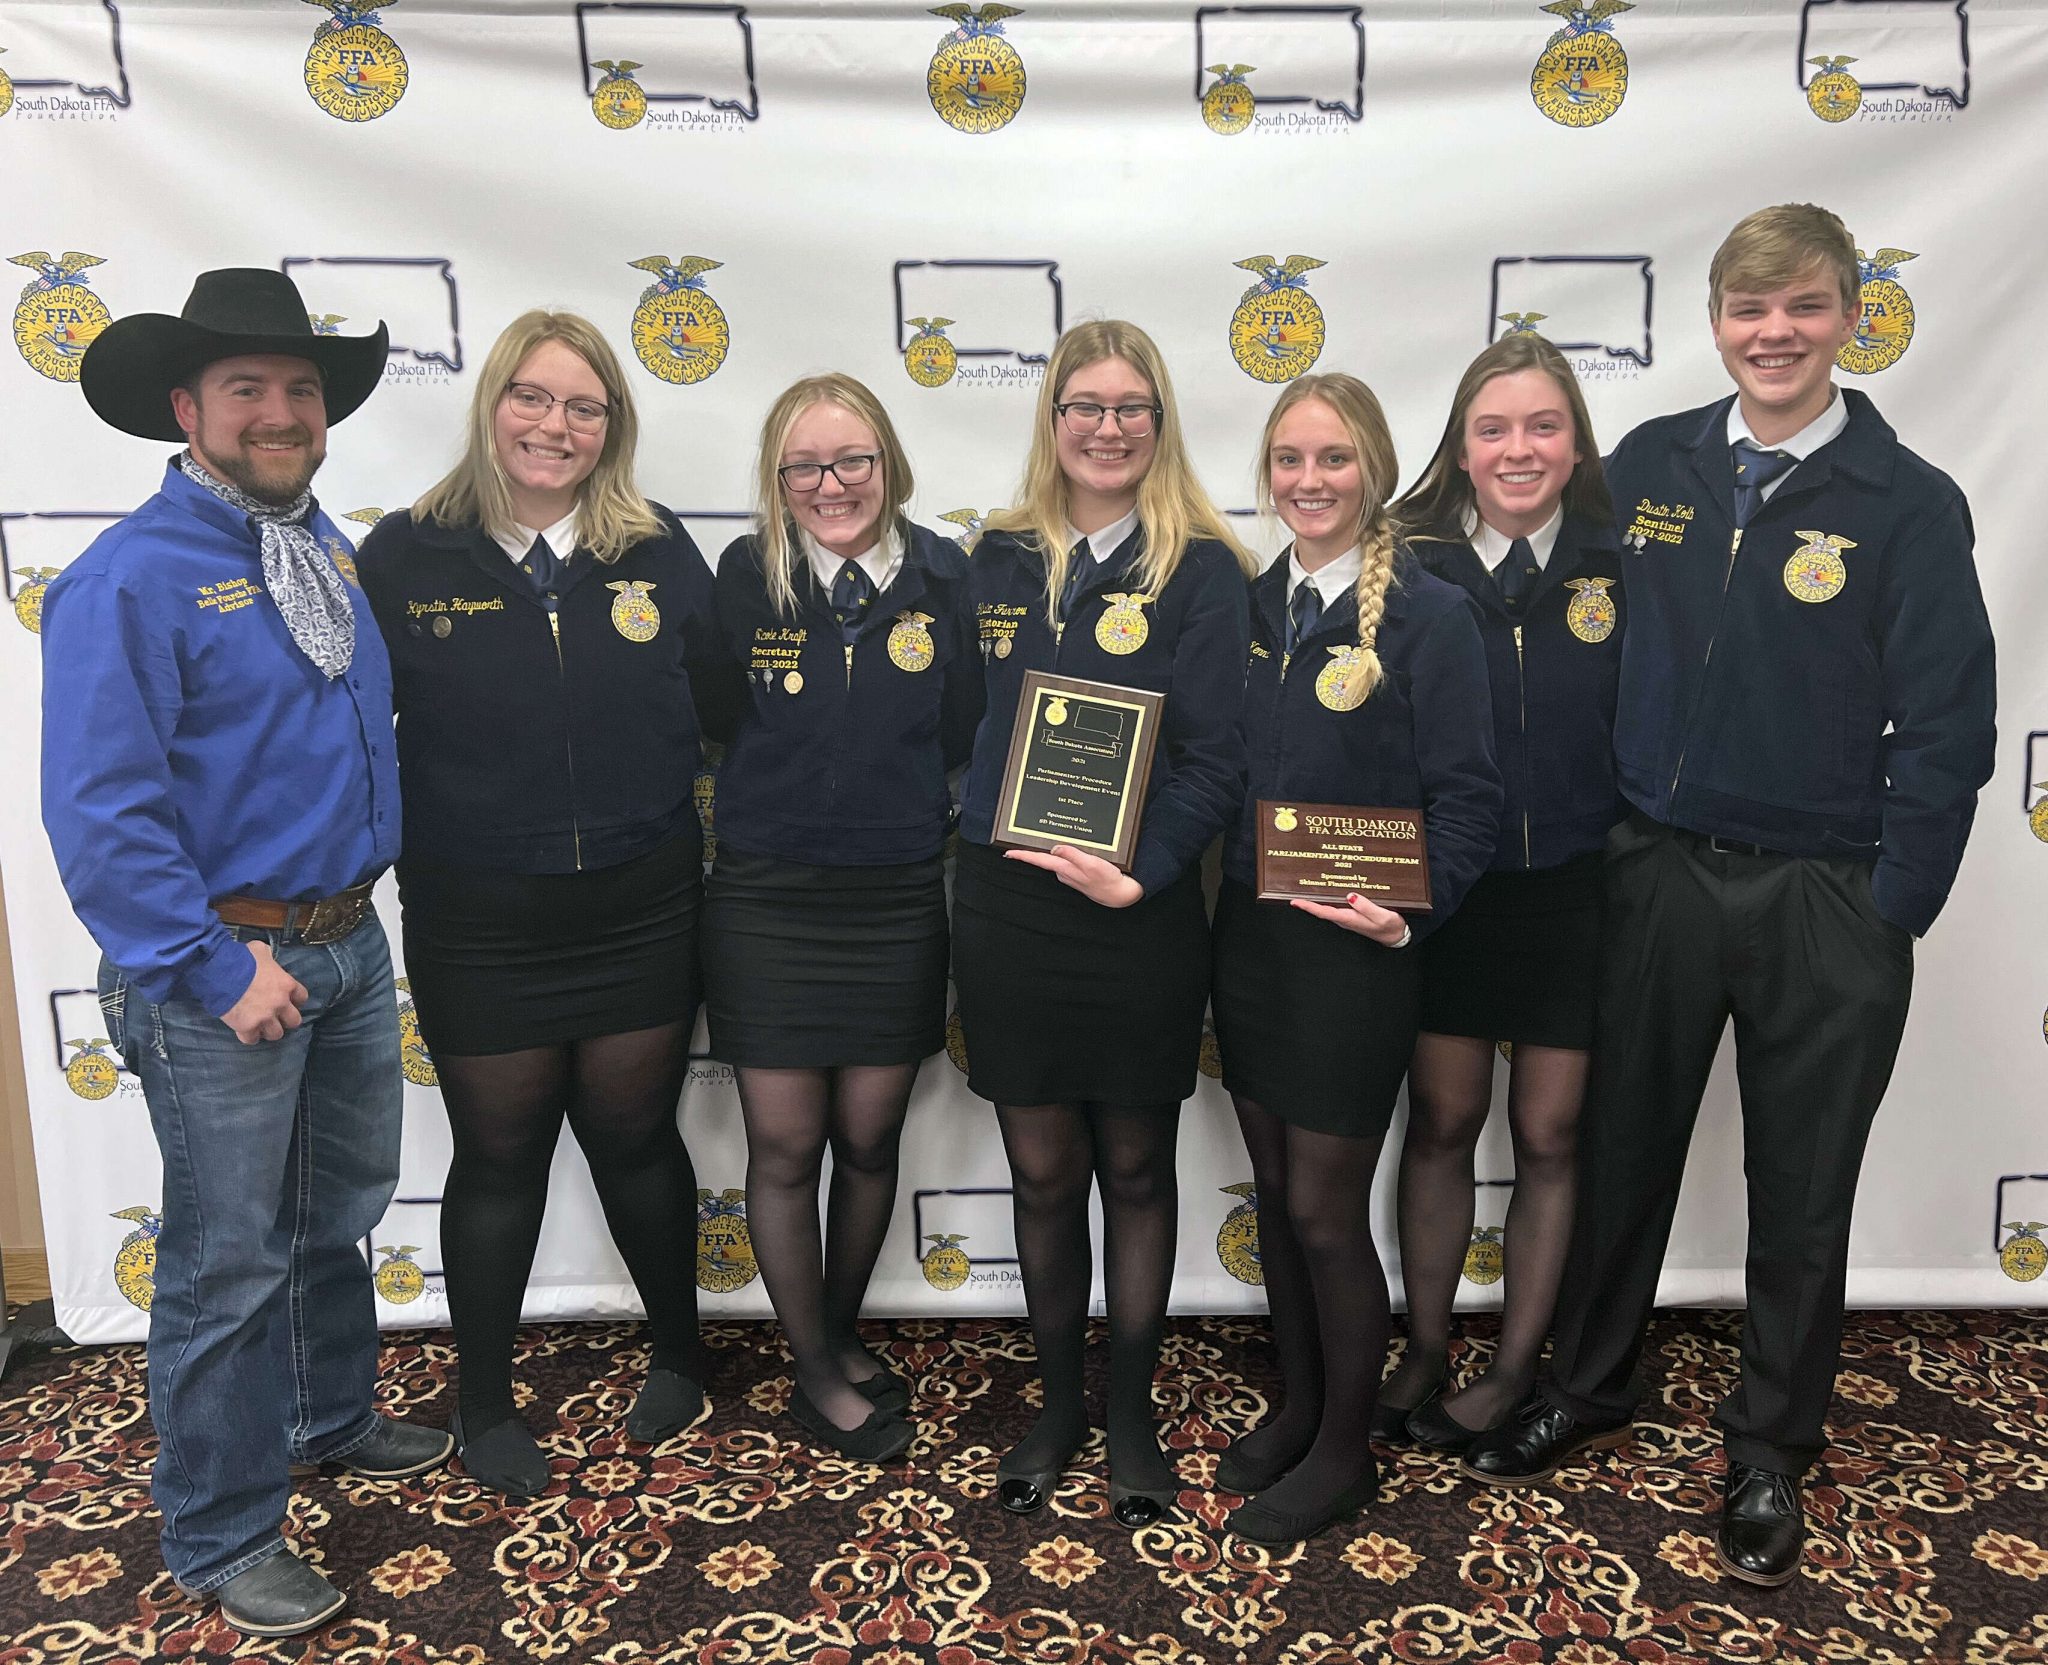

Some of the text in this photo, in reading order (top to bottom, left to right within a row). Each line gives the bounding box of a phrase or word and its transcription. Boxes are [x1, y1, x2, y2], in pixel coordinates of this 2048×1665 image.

[322, 36, 391, 68] AGRICULTURAL
[338, 50, 378, 67] FFA
[1549, 42, 1616, 72] AGRICULTURAL
[943, 47, 1008, 76] AGRICULTURAL
[959, 60, 996, 75] FFA
[1564, 57, 1600, 72] FFA
[609, 91, 630, 100] FFA
[1823, 84, 1844, 93] FFA
[16, 97, 115, 111] South Dakota FFA
[326, 88, 385, 111] EDUCATION
[1219, 95, 1240, 103] FFA
[1861, 99, 1953, 113] South Dakota FFA
[948, 99, 1005, 120] EDUCATION
[1550, 96, 1609, 117] EDUCATION
[16, 111, 117, 122] Foundation
[647, 111, 680, 123] South
[682, 111, 720, 123] Dakota
[723, 112, 744, 123] FFA
[1254, 113, 1349, 127] South Dakota FFA
[1860, 113, 1953, 123] Foundation
[647, 121, 744, 132] Foundation
[1254, 125, 1350, 135] Foundation
[31, 295, 98, 326] AGRICULTURAL
[1863, 290, 1900, 319] ULTURAL
[1864, 303, 1887, 317] FA
[44, 308, 83, 323] FFA
[647, 299, 714, 329] AGRICULTURAL
[662, 312, 699, 327] FFA
[1247, 299, 1309, 328] AGRICULTURAL
[1261, 311, 1297, 326] FFA
[921, 348, 941, 356] FFA
[1843, 342, 1891, 360] DUCATION
[38, 349, 79, 368] EDUCAT
[654, 352, 708, 371] EDUCATION
[1250, 351, 1304, 369] EDUCATION
[1579, 358, 1616, 371] Dakota
[1619, 359, 1639, 370] FFA
[387, 362, 425, 375] Dakota
[428, 363, 449, 375] FFA
[957, 365, 988, 378] South
[991, 365, 1028, 378] Dakota
[1031, 366, 1044, 378] FF
[385, 376, 450, 385] ndation
[957, 378, 1040, 388] Foundatio
[1636, 515, 1686, 534] Sentinel
[1628, 525, 1683, 544] 2021-2022
[215, 578, 248, 592] Bishop
[751, 646, 801, 659] Secretary
[751, 660, 799, 669] 2021-2022
[1037, 767, 1112, 786] Parliamentary Procedure
[1026, 773, 1121, 797] Leadership Development Event
[1067, 798, 1084, 806] Place
[1047, 811, 1088, 824] Sponsored by
[1305, 815, 1418, 832] SOUTH DAKOTA
[1048, 820, 1073, 830] Farmers
[1074, 824, 1093, 833] Union
[1309, 826, 1416, 840] FFA ASSOCIATION
[1338, 844, 1364, 852] STATE
[1267, 849, 1420, 865] PARLIAMENTARY PROCEDURE TEAM
[1321, 872, 1367, 882] Sponsored by
[1327, 880, 1360, 889] Financial
[1361, 882, 1391, 890] Services
[82, 1064, 102, 1073] FFA
[690, 1066, 719, 1079] South
[704, 1233, 737, 1246] FFA
[1475, 1250, 1493, 1258] FFA
[701, 1264, 747, 1280] DUCATION
[970, 1270, 998, 1281] South
[425, 1284, 445, 1294] Sou
